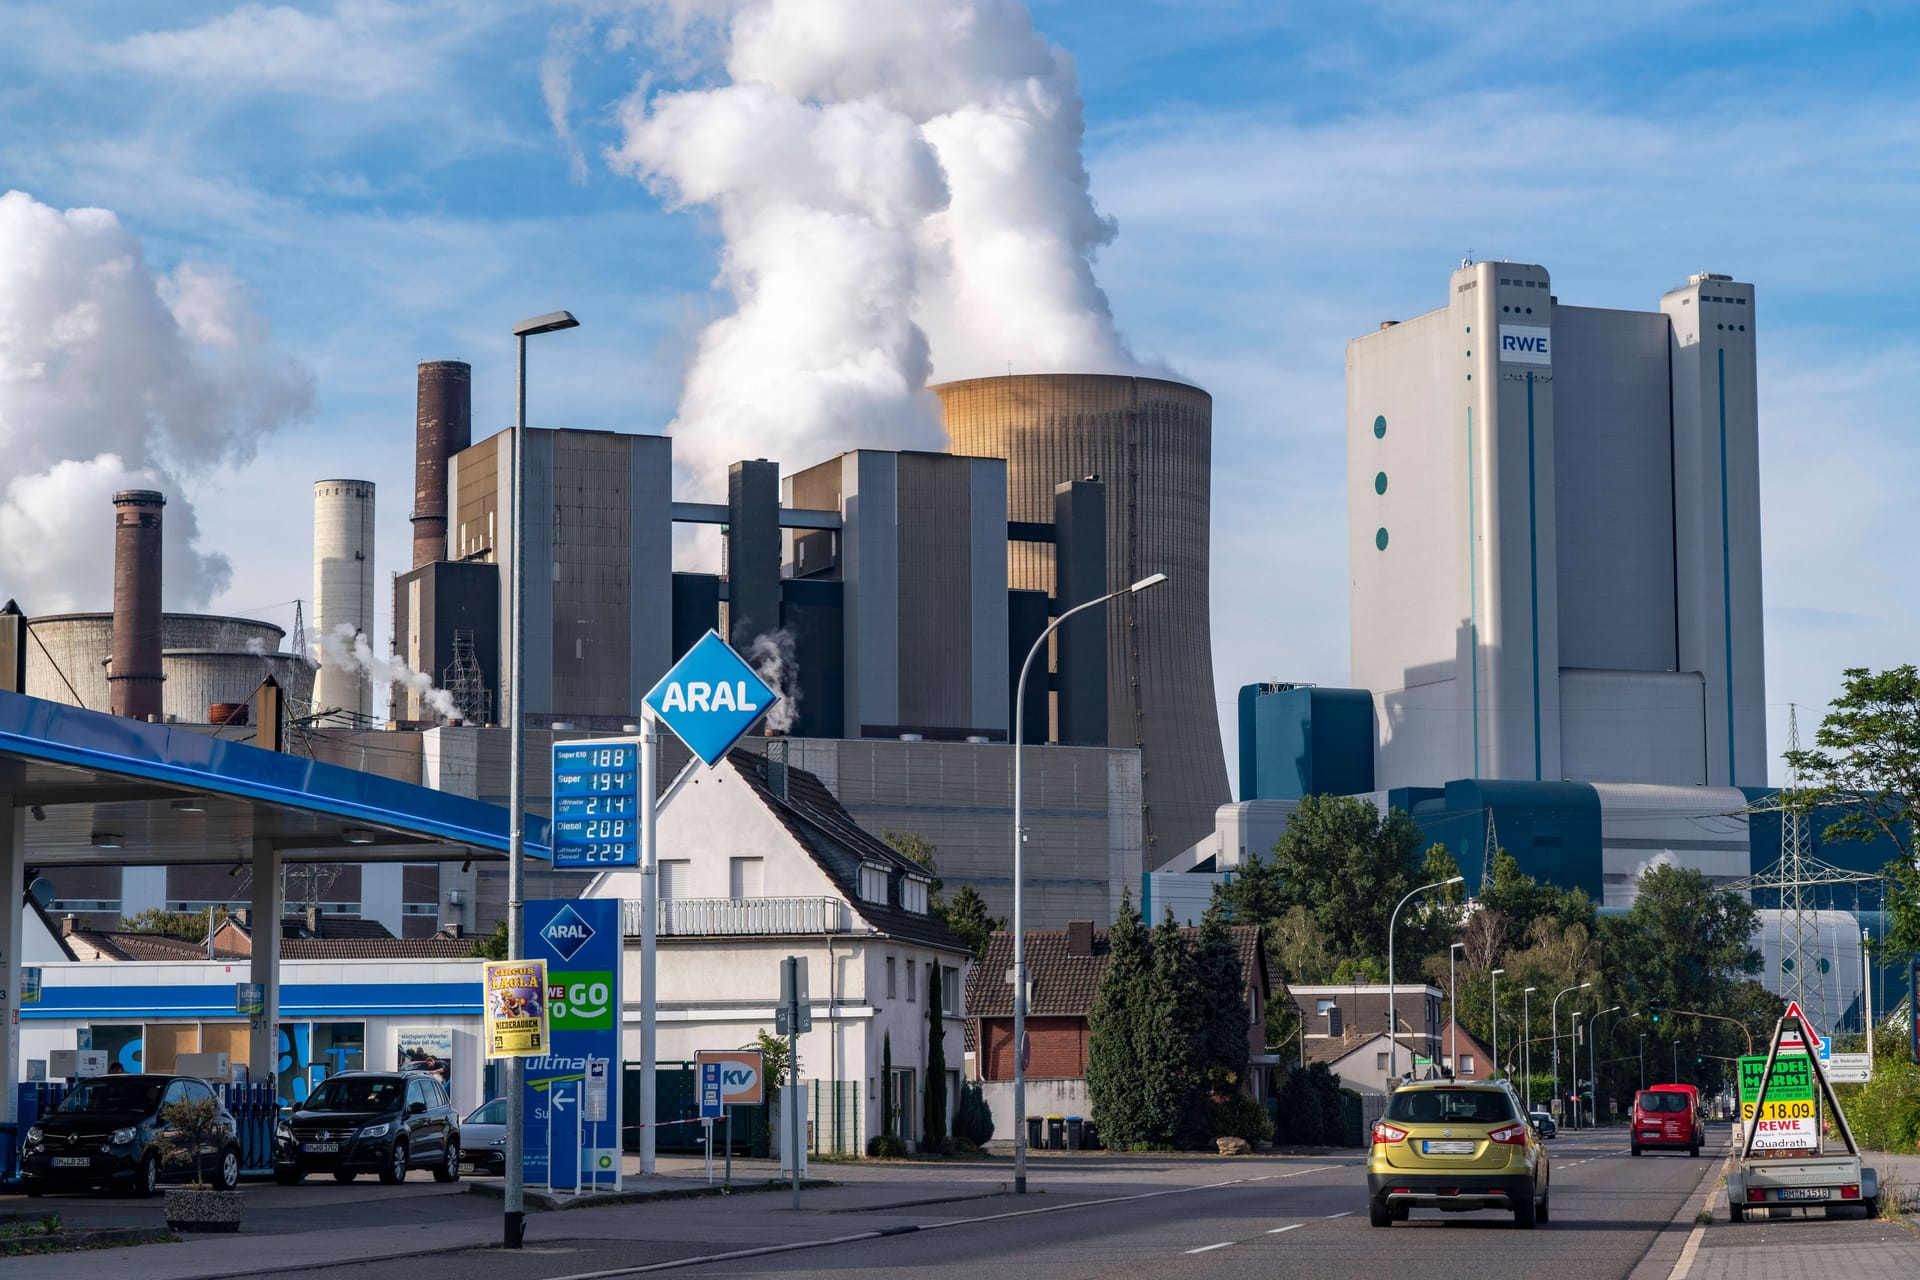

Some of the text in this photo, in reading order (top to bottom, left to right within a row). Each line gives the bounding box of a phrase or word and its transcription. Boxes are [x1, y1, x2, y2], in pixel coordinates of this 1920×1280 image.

[1503, 335, 1548, 353] RWE
[661, 681, 757, 713] ARAL
[592, 749, 624, 767] 188
[557, 775, 581, 784] Super
[592, 773, 624, 791] 194
[586, 797, 624, 815] 214
[557, 822, 582, 830] Diesel
[586, 820, 624, 838] 208
[586, 844, 624, 862] 229
[547, 925, 587, 938] ARAL
[494, 967, 534, 976] CIRCUS
[491, 976, 539, 991] LAOLA
[547, 987, 564, 998] WE
[569, 983, 608, 1005] GO
[252, 1021, 258, 1030] 2
[1745, 1074, 1807, 1087] MRKT
[1769, 1104, 1814, 1118] 18.09.
[1759, 1120, 1801, 1131] REWE
[1756, 1139, 1807, 1148] Quadrath
